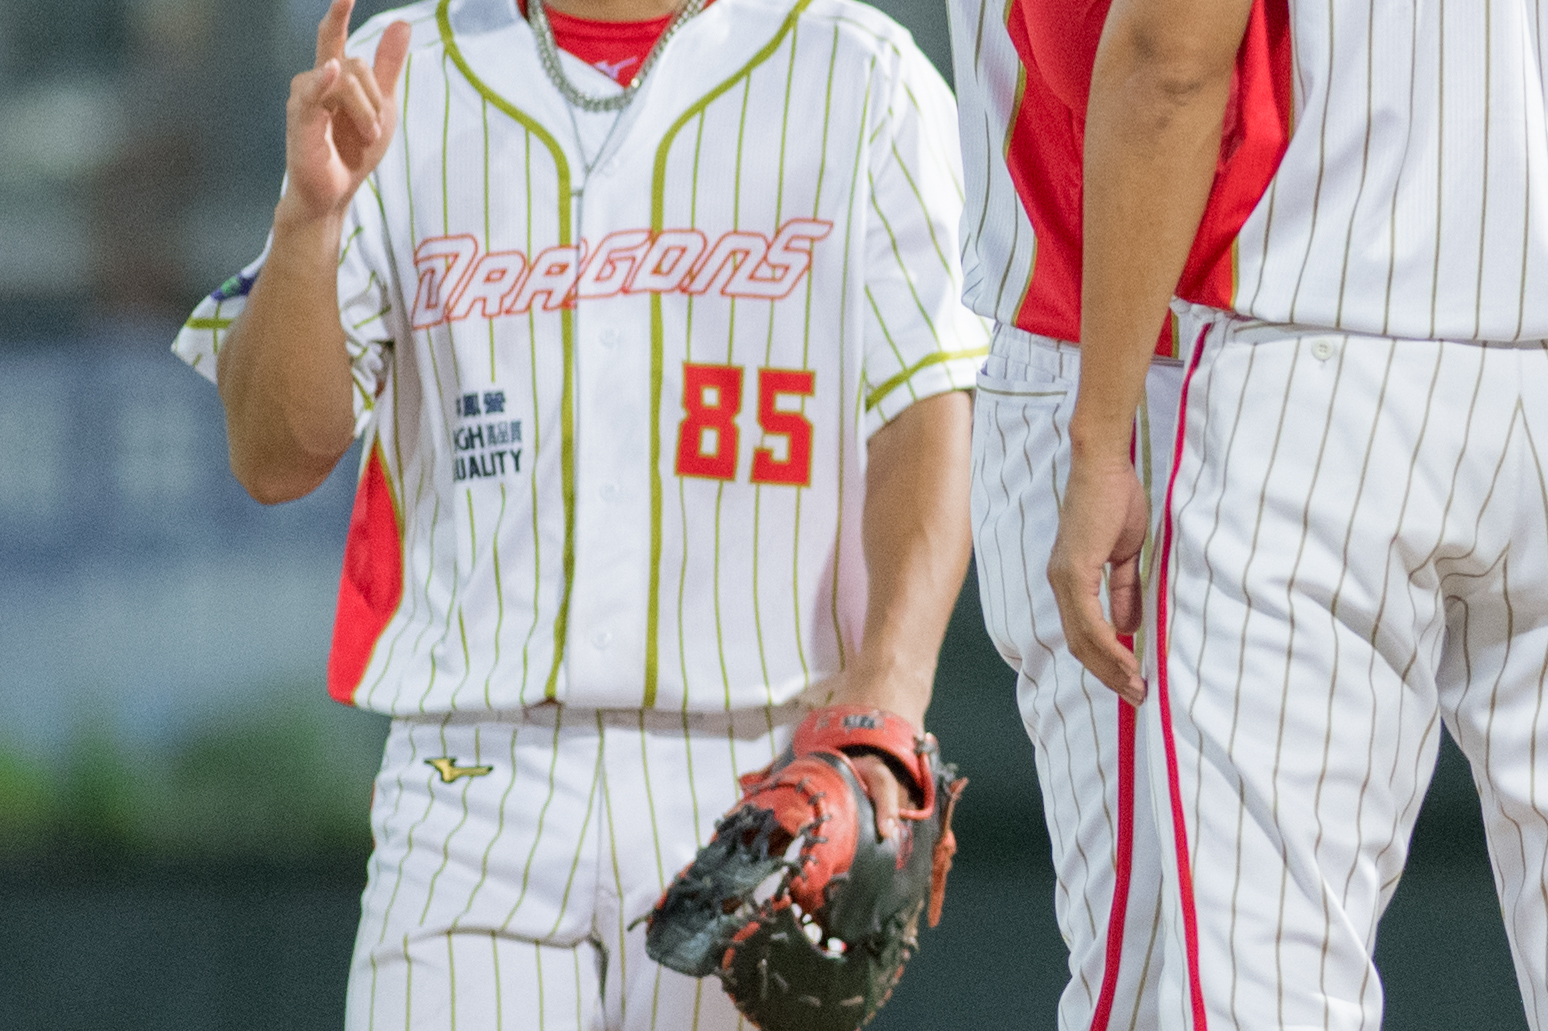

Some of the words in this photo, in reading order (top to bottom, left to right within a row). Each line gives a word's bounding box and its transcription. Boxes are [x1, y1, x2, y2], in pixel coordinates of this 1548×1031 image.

[411, 218, 833, 329] DRAGONS
[454, 449, 522, 482] UALITY
[674, 362, 815, 487] 85
